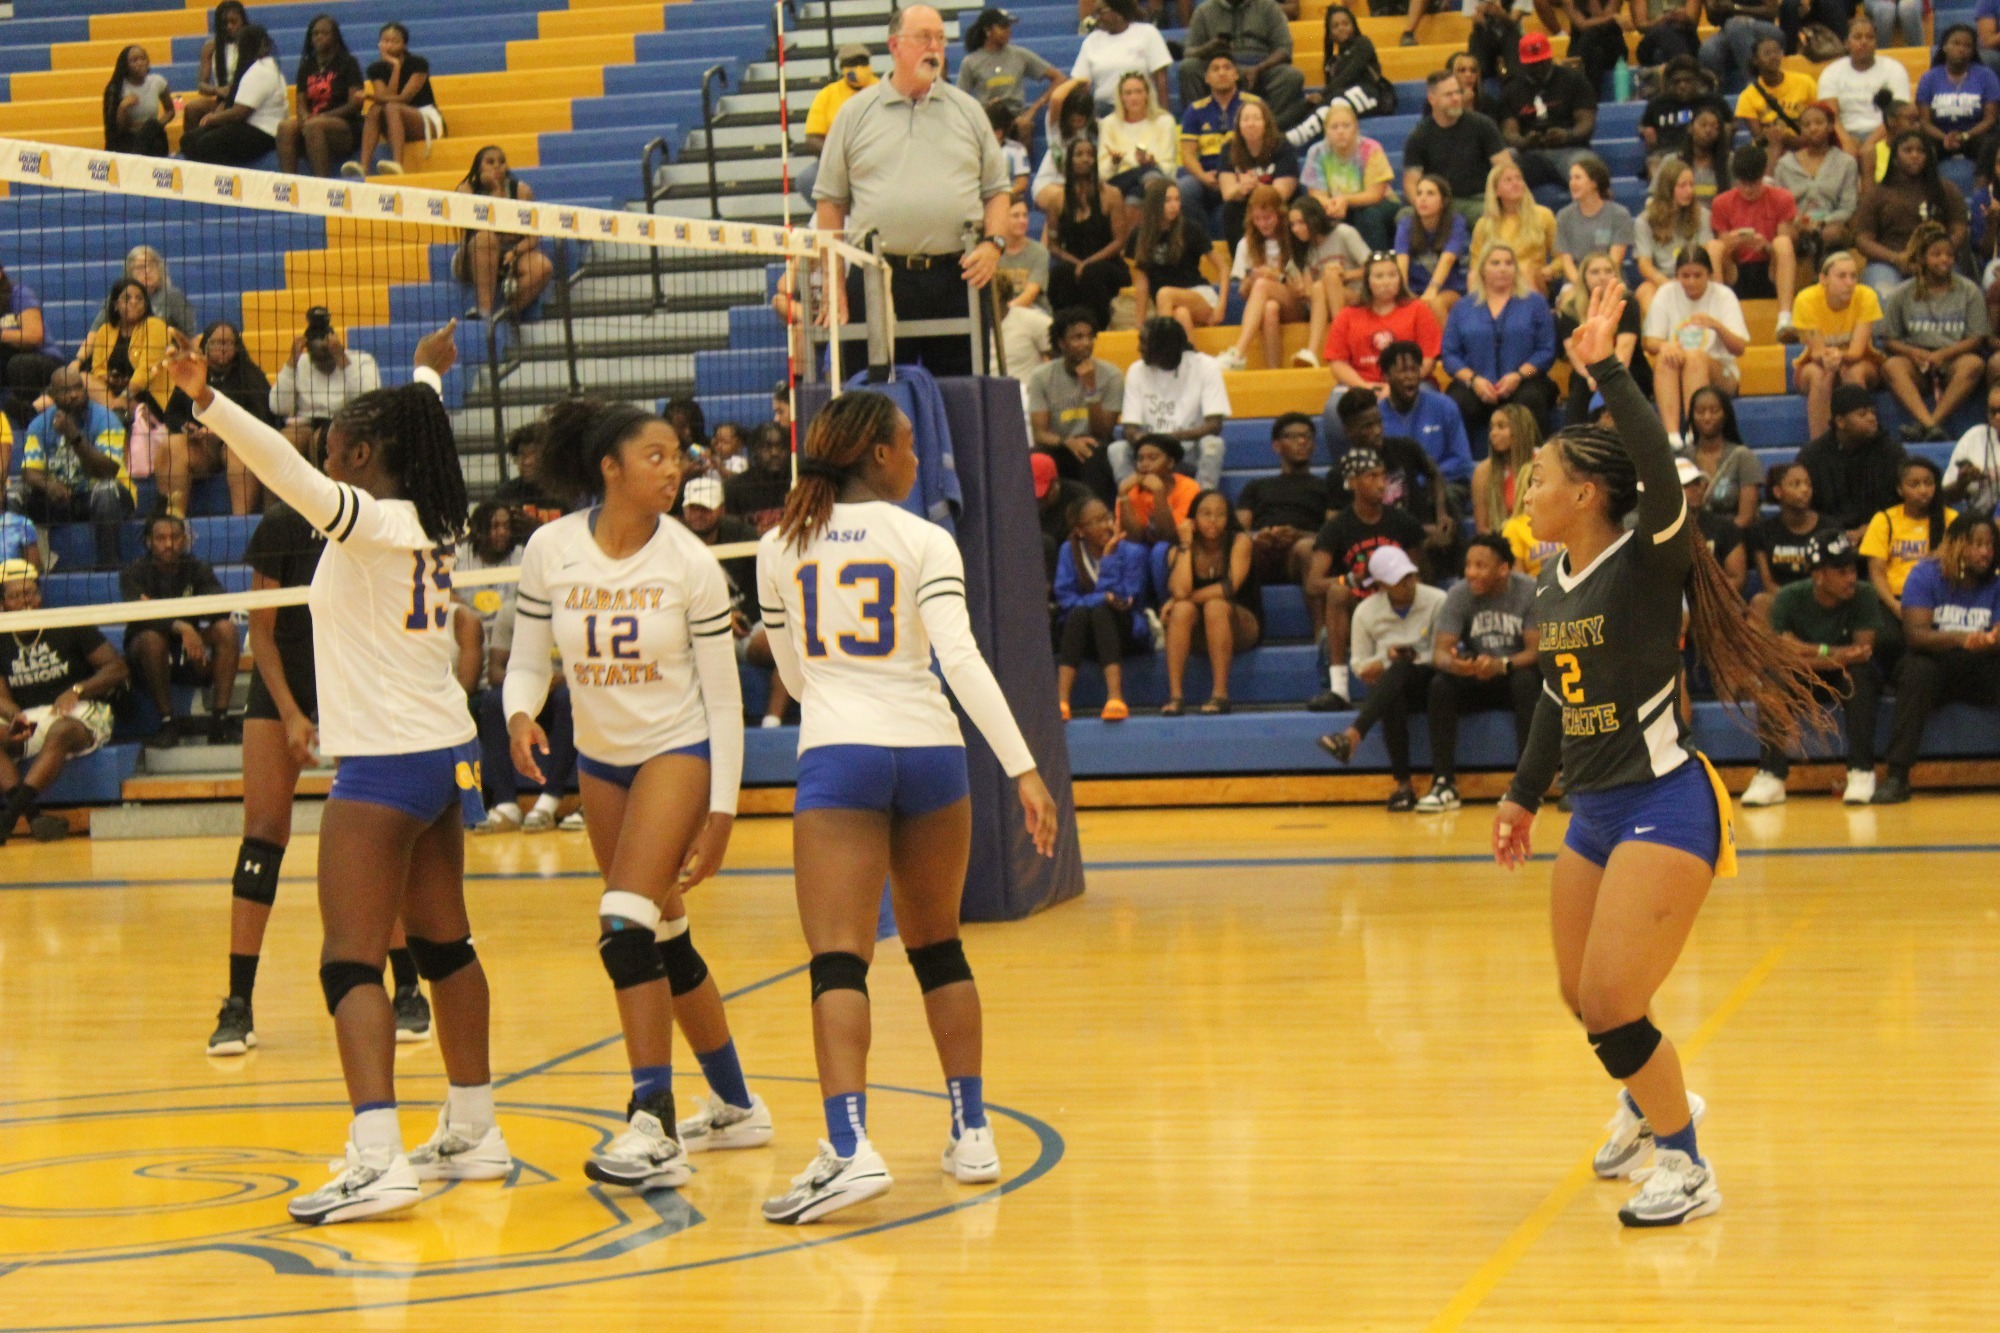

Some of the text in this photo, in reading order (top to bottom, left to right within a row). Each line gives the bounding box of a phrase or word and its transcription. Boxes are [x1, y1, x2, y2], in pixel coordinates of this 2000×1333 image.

[19, 153, 41, 164] GOLDEN
[22, 162, 40, 174] RAMS
[88, 160, 110, 172] GOLDEN
[92, 170, 109, 181] RAMS
[152, 169, 173, 180] GOLDEN
[157, 178, 172, 189] RAMS
[825, 529, 868, 543] ASU
[564, 586, 665, 611] ALBANY
[793, 559, 899, 660] 13
[584, 613, 640, 660] 12
[1538, 614, 1605, 651] LBANY
[12, 650, 61, 675] BLACK
[30, 641, 50, 659] AM
[8, 661, 69, 688] HISTORY
[573, 660, 665, 688] STATE
[1555, 653, 1585, 703] 2
[1562, 702, 1620, 735] TATE
